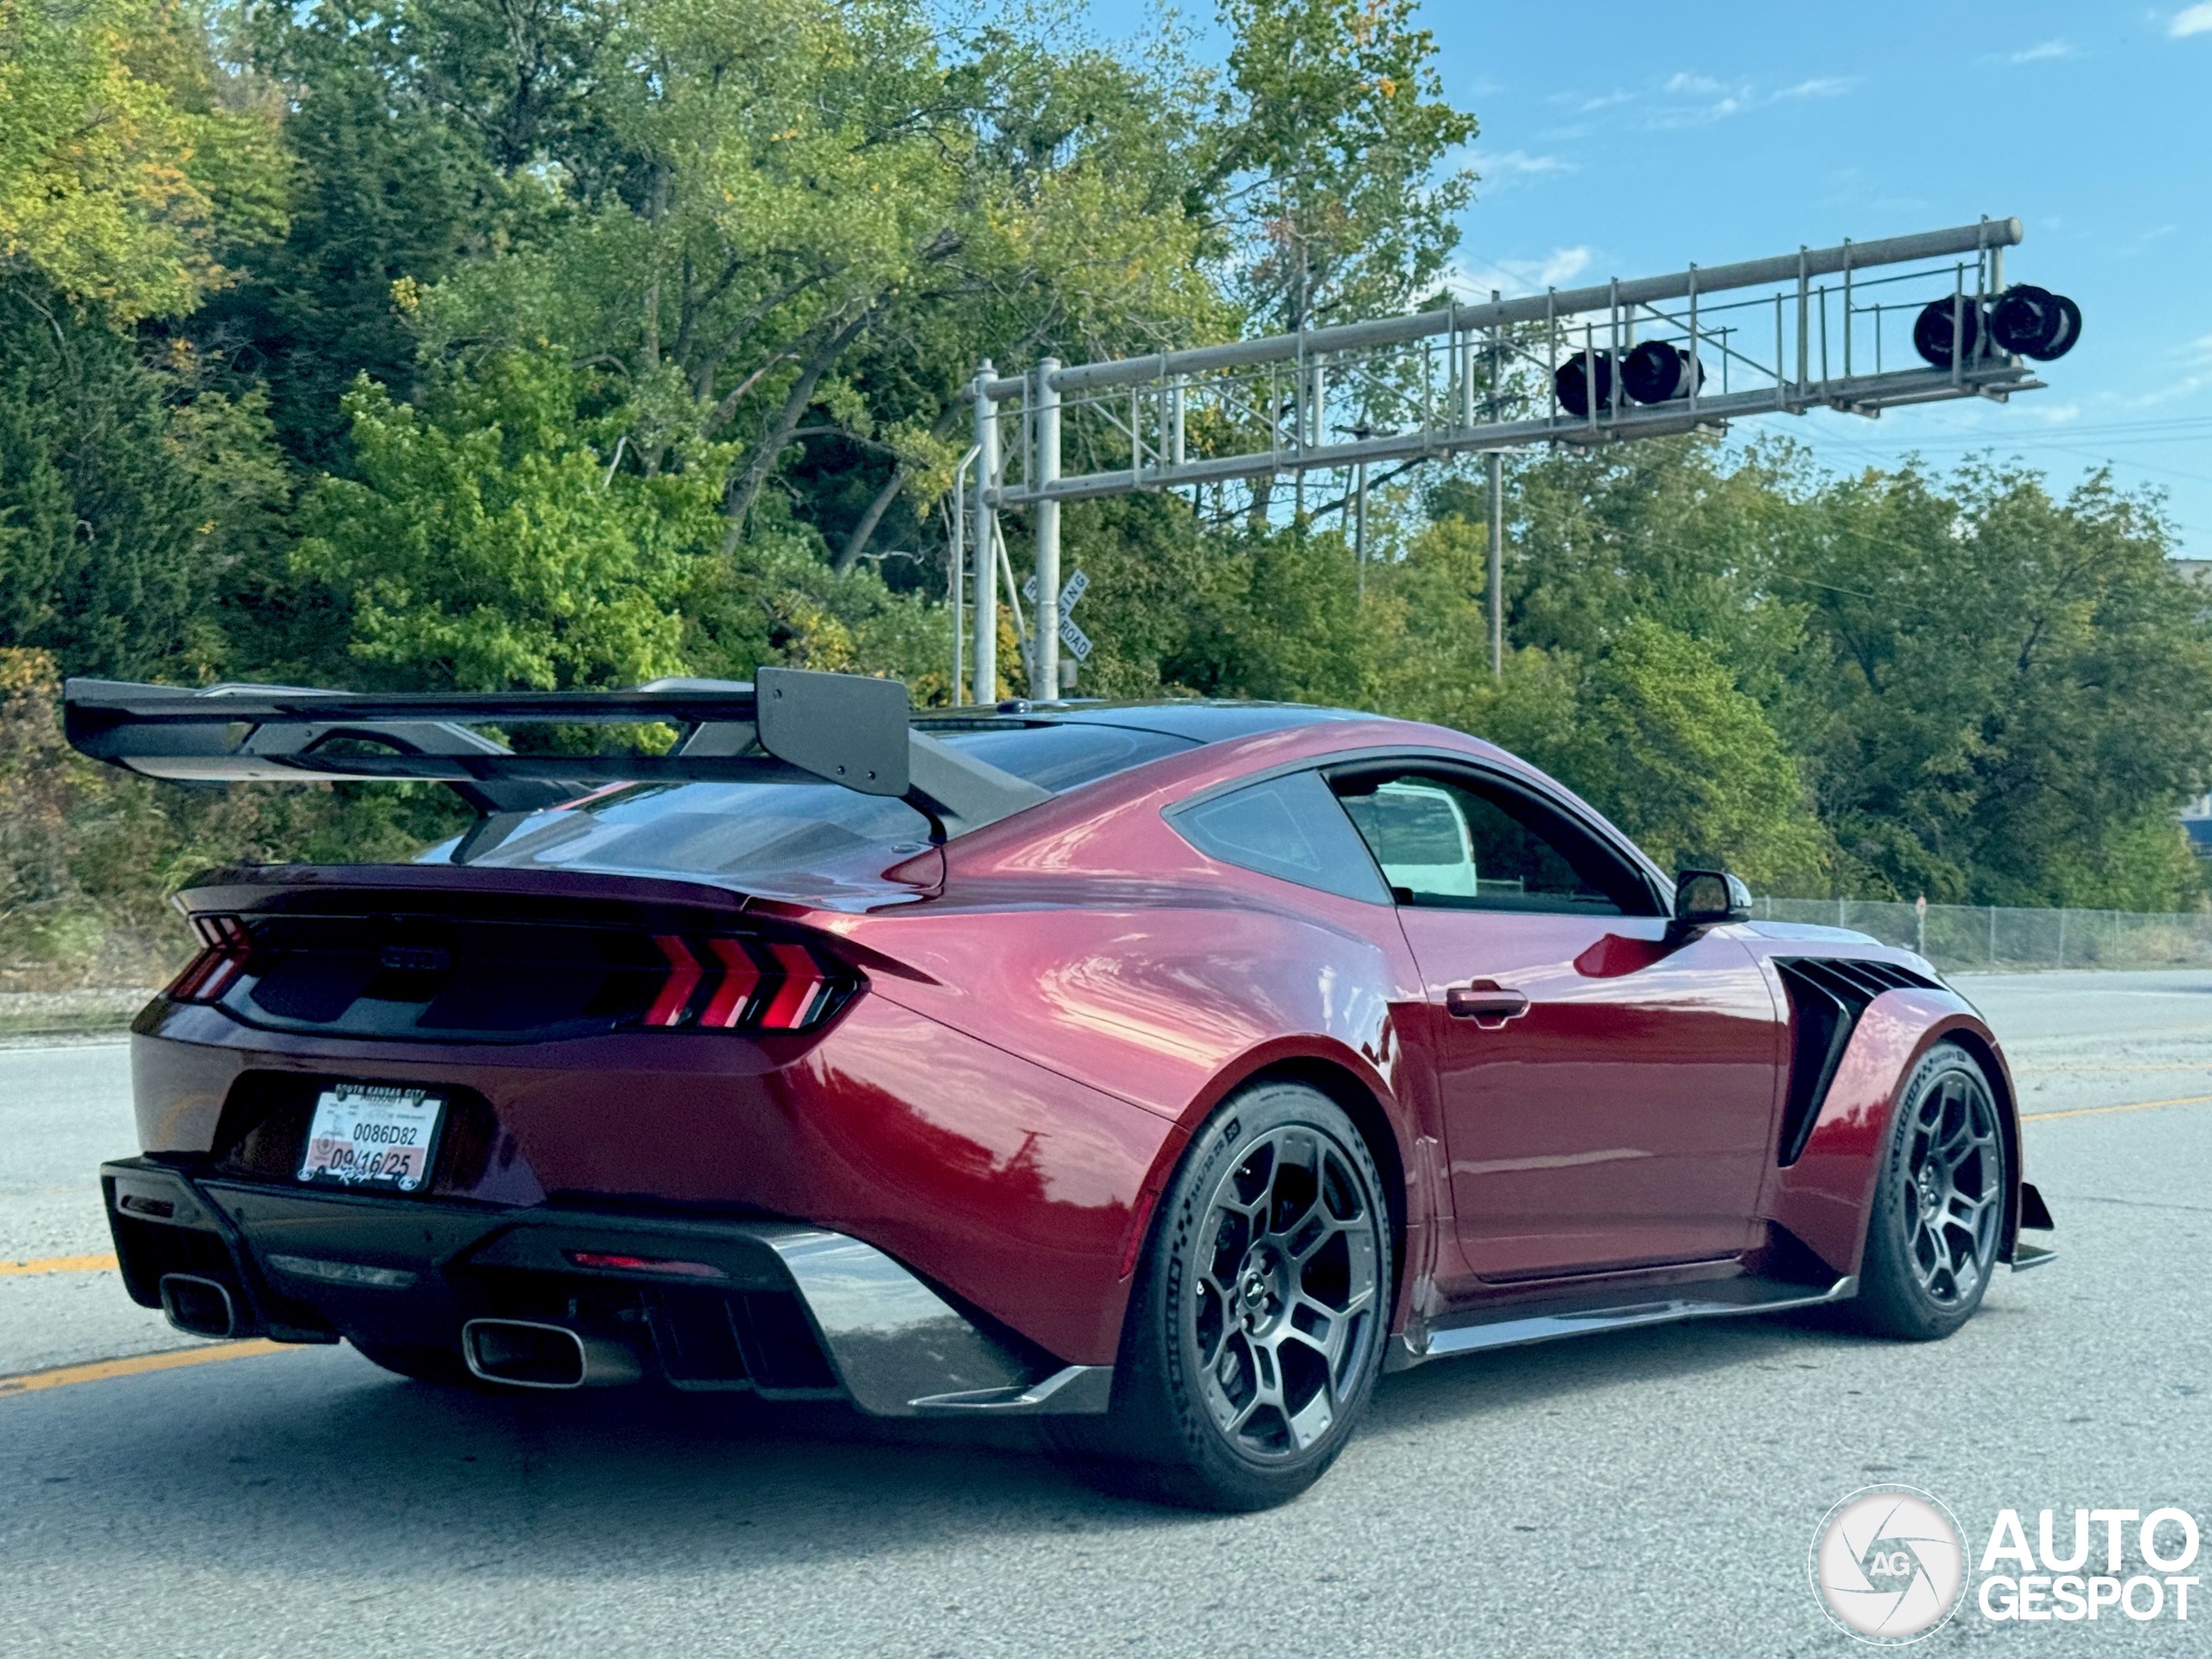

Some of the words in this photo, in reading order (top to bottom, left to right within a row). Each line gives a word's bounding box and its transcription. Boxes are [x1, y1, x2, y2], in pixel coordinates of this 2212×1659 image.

[1059, 620, 1088, 655] ROAD
[353, 1123, 417, 1146] 0086D82
[331, 1148, 411, 1176] 09/16/25
